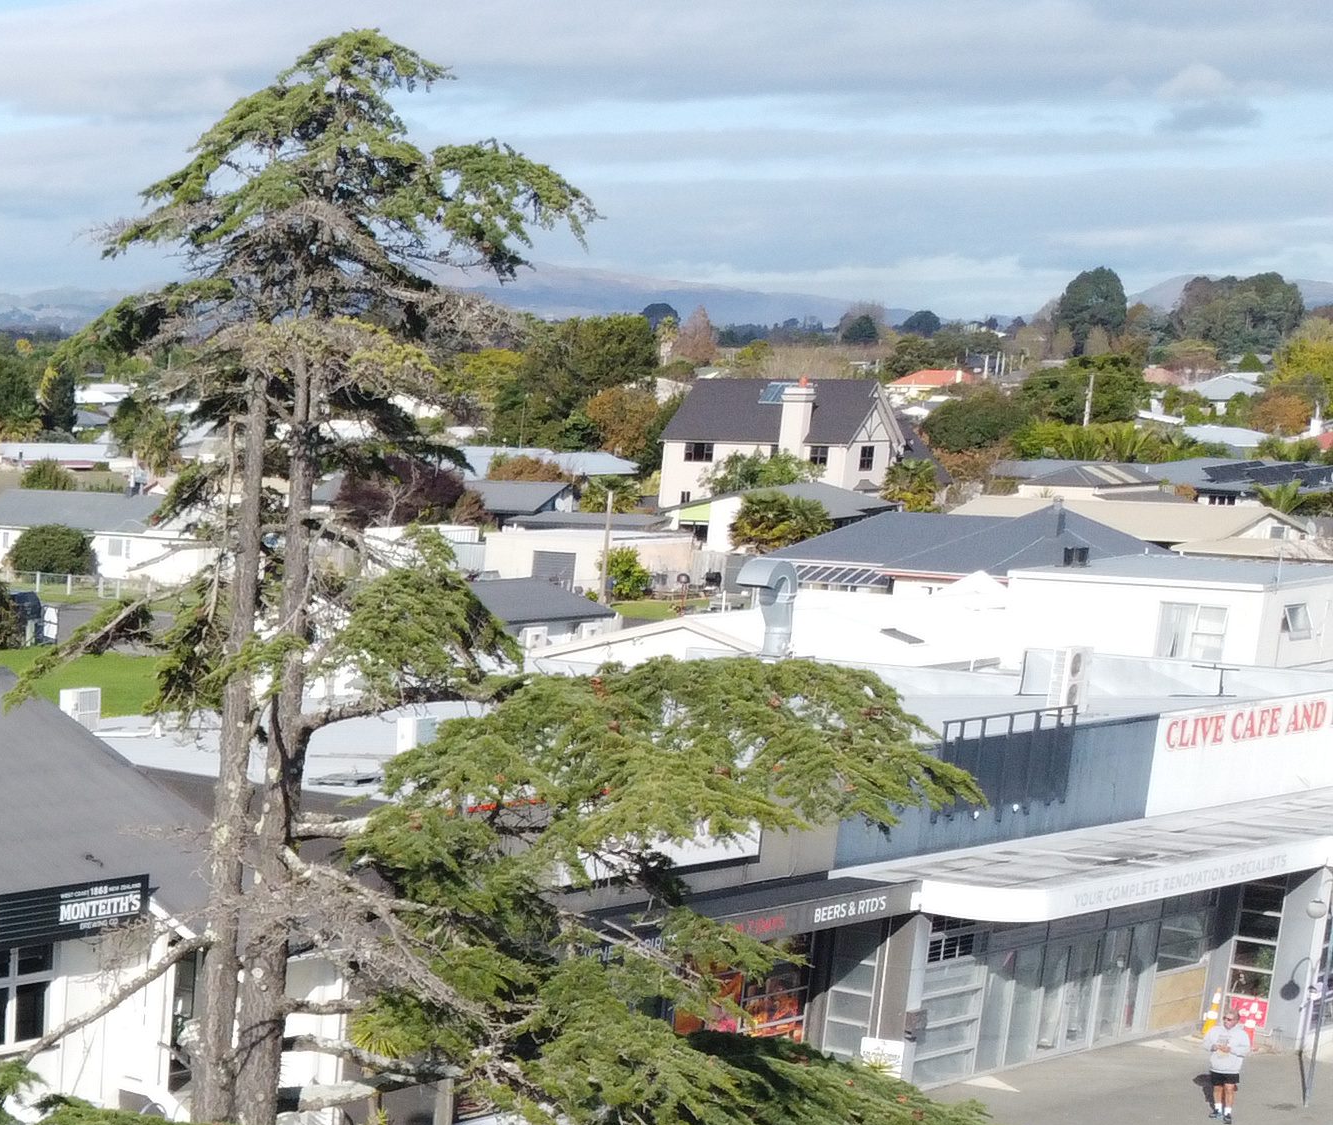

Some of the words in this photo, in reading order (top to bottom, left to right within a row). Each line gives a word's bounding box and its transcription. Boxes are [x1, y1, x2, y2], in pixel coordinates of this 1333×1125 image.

[1165, 714, 1227, 750] CLIVE
[1231, 706, 1282, 742] CAFE
[1286, 699, 1328, 733] AND
[1106, 879, 1160, 902] COMPLETE
[1163, 867, 1226, 891] RENOVATION
[1228, 854, 1288, 877] SPECIALISTS
[58, 893, 141, 922] MONTEITH'S
[813, 902, 848, 923] BEERS
[847, 901, 857, 916] &
[857, 896, 888, 915] RTD'S
